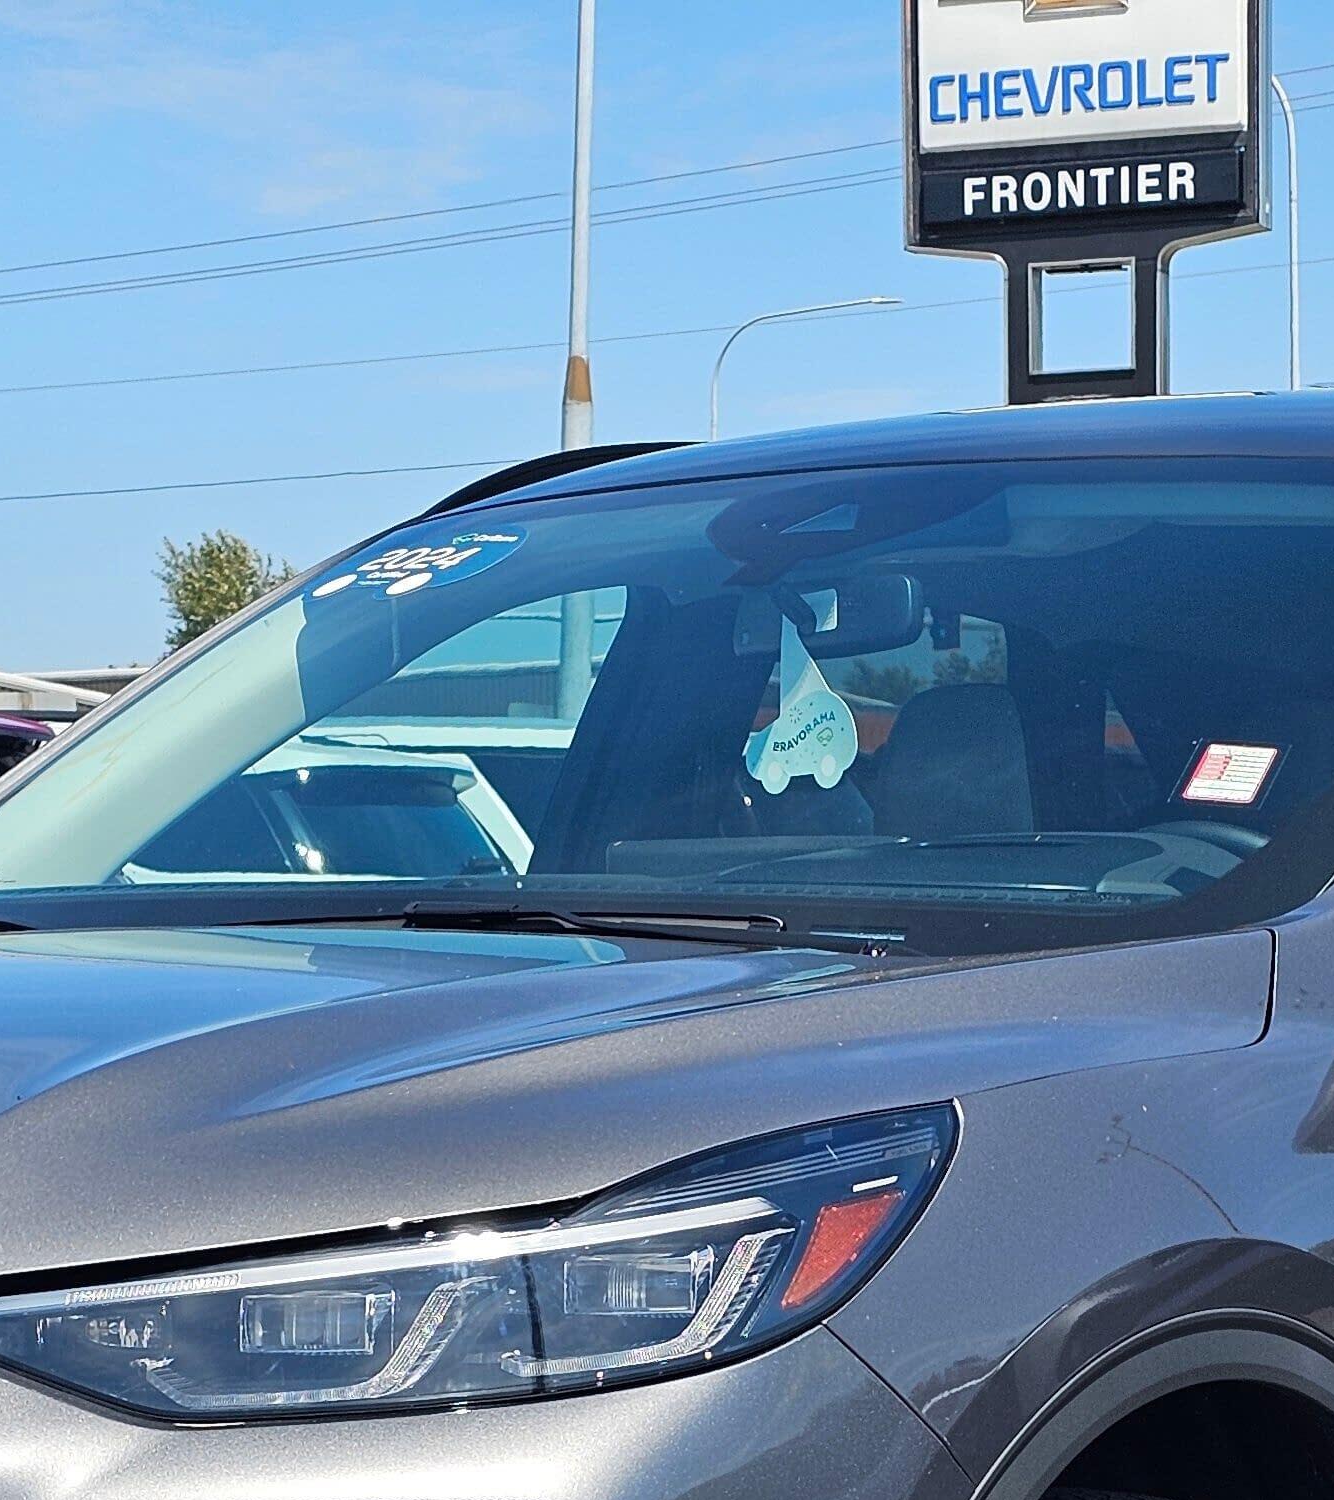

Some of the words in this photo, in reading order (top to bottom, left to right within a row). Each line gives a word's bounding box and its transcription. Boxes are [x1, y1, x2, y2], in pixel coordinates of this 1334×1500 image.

[929, 53, 1231, 125] CHEVROLET
[963, 162, 1196, 216] FRONTIER
[356, 546, 483, 571] 2024
